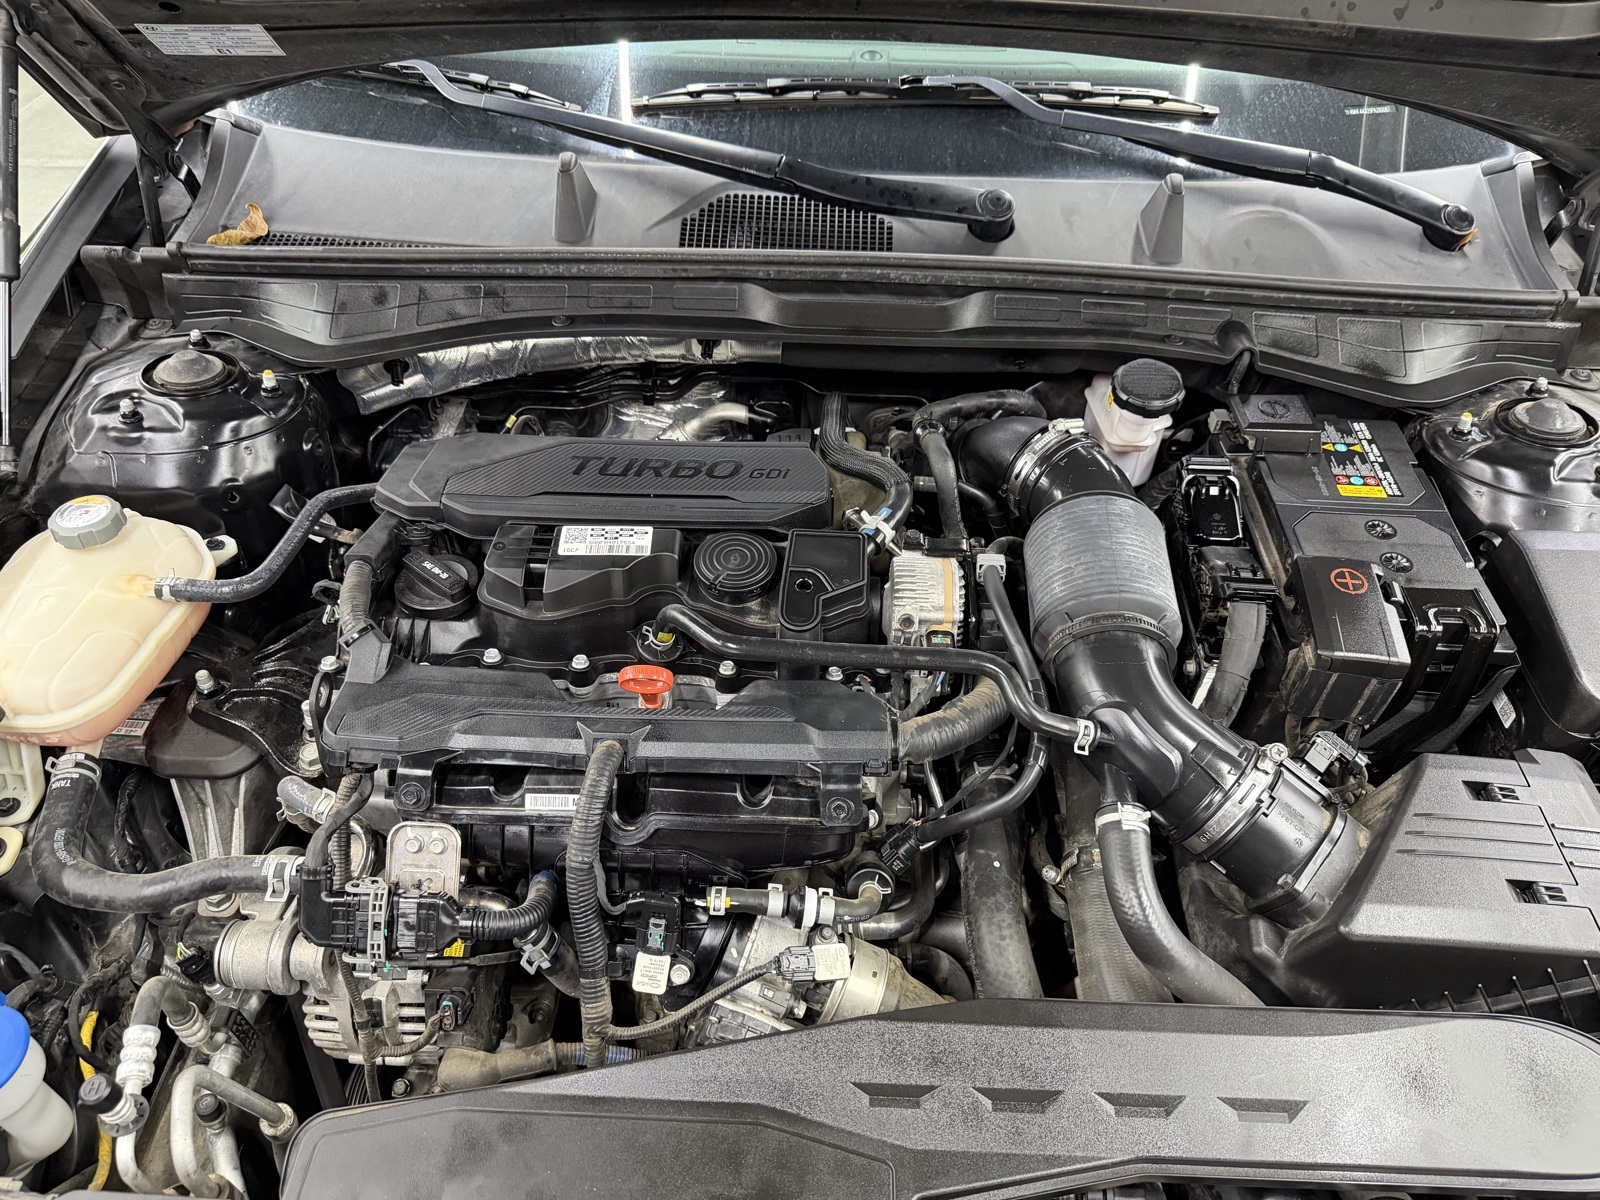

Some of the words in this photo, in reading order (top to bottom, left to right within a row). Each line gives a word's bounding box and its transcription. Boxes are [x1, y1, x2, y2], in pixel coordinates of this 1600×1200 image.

[571, 455, 743, 480] TURBO
[748, 468, 791, 480] GDi
[51, 779, 71, 791] TANK
